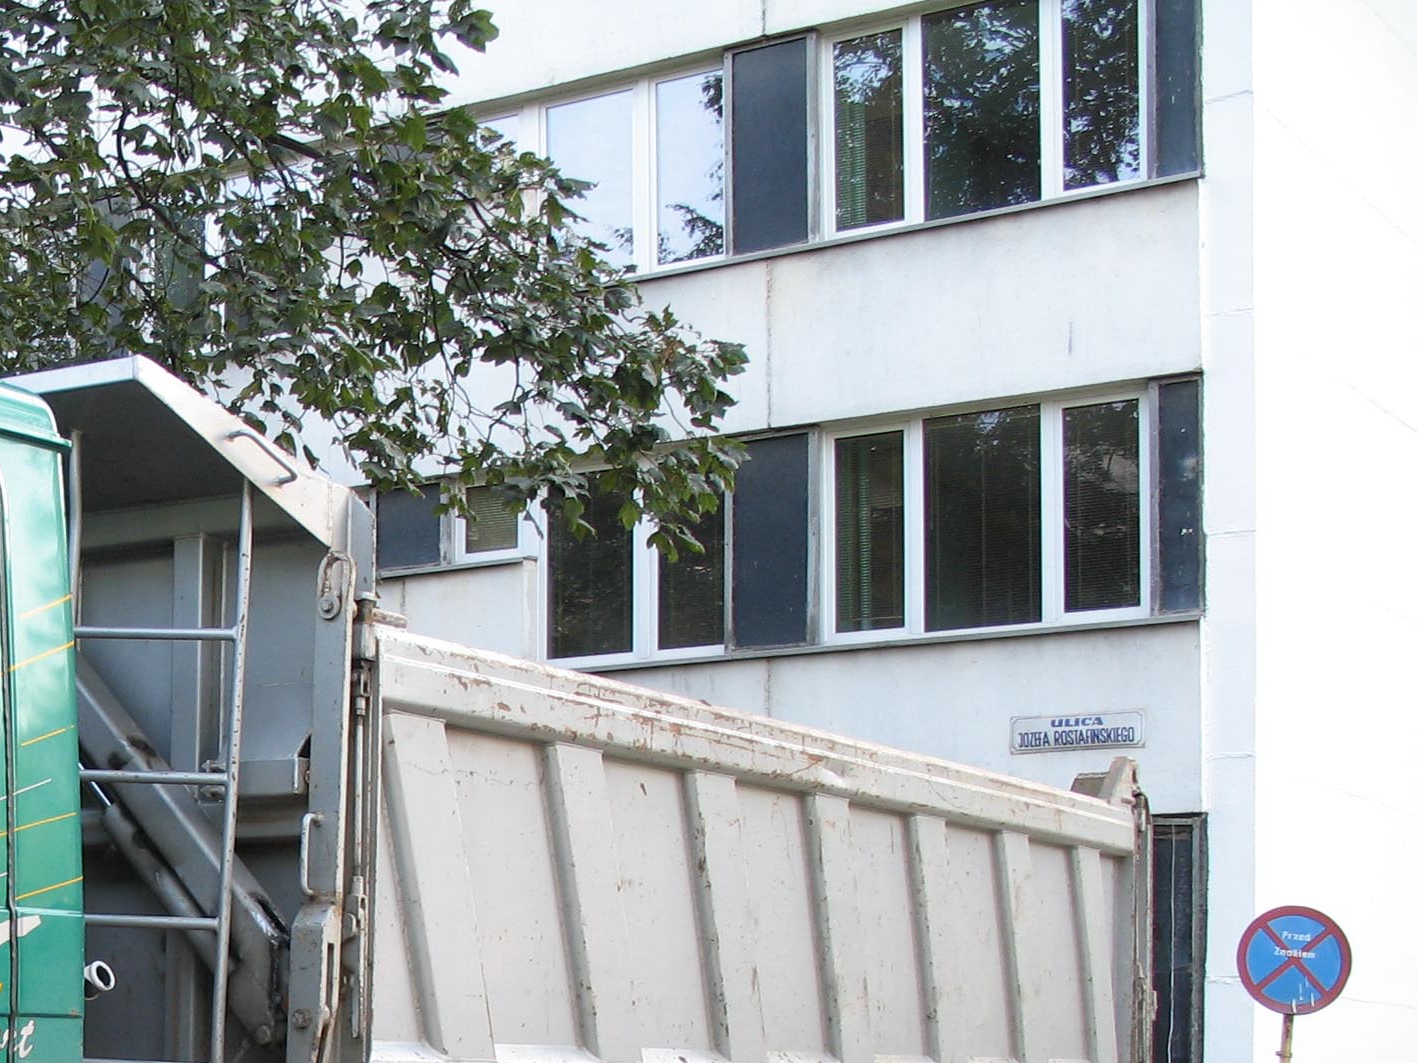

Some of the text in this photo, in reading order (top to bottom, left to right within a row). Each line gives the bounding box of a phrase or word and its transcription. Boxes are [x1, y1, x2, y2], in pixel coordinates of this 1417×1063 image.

[1050, 717, 1104, 727] ULICA
[1281, 930, 1311, 942] Przed
[1273, 945, 1316, 958] Znakiem
